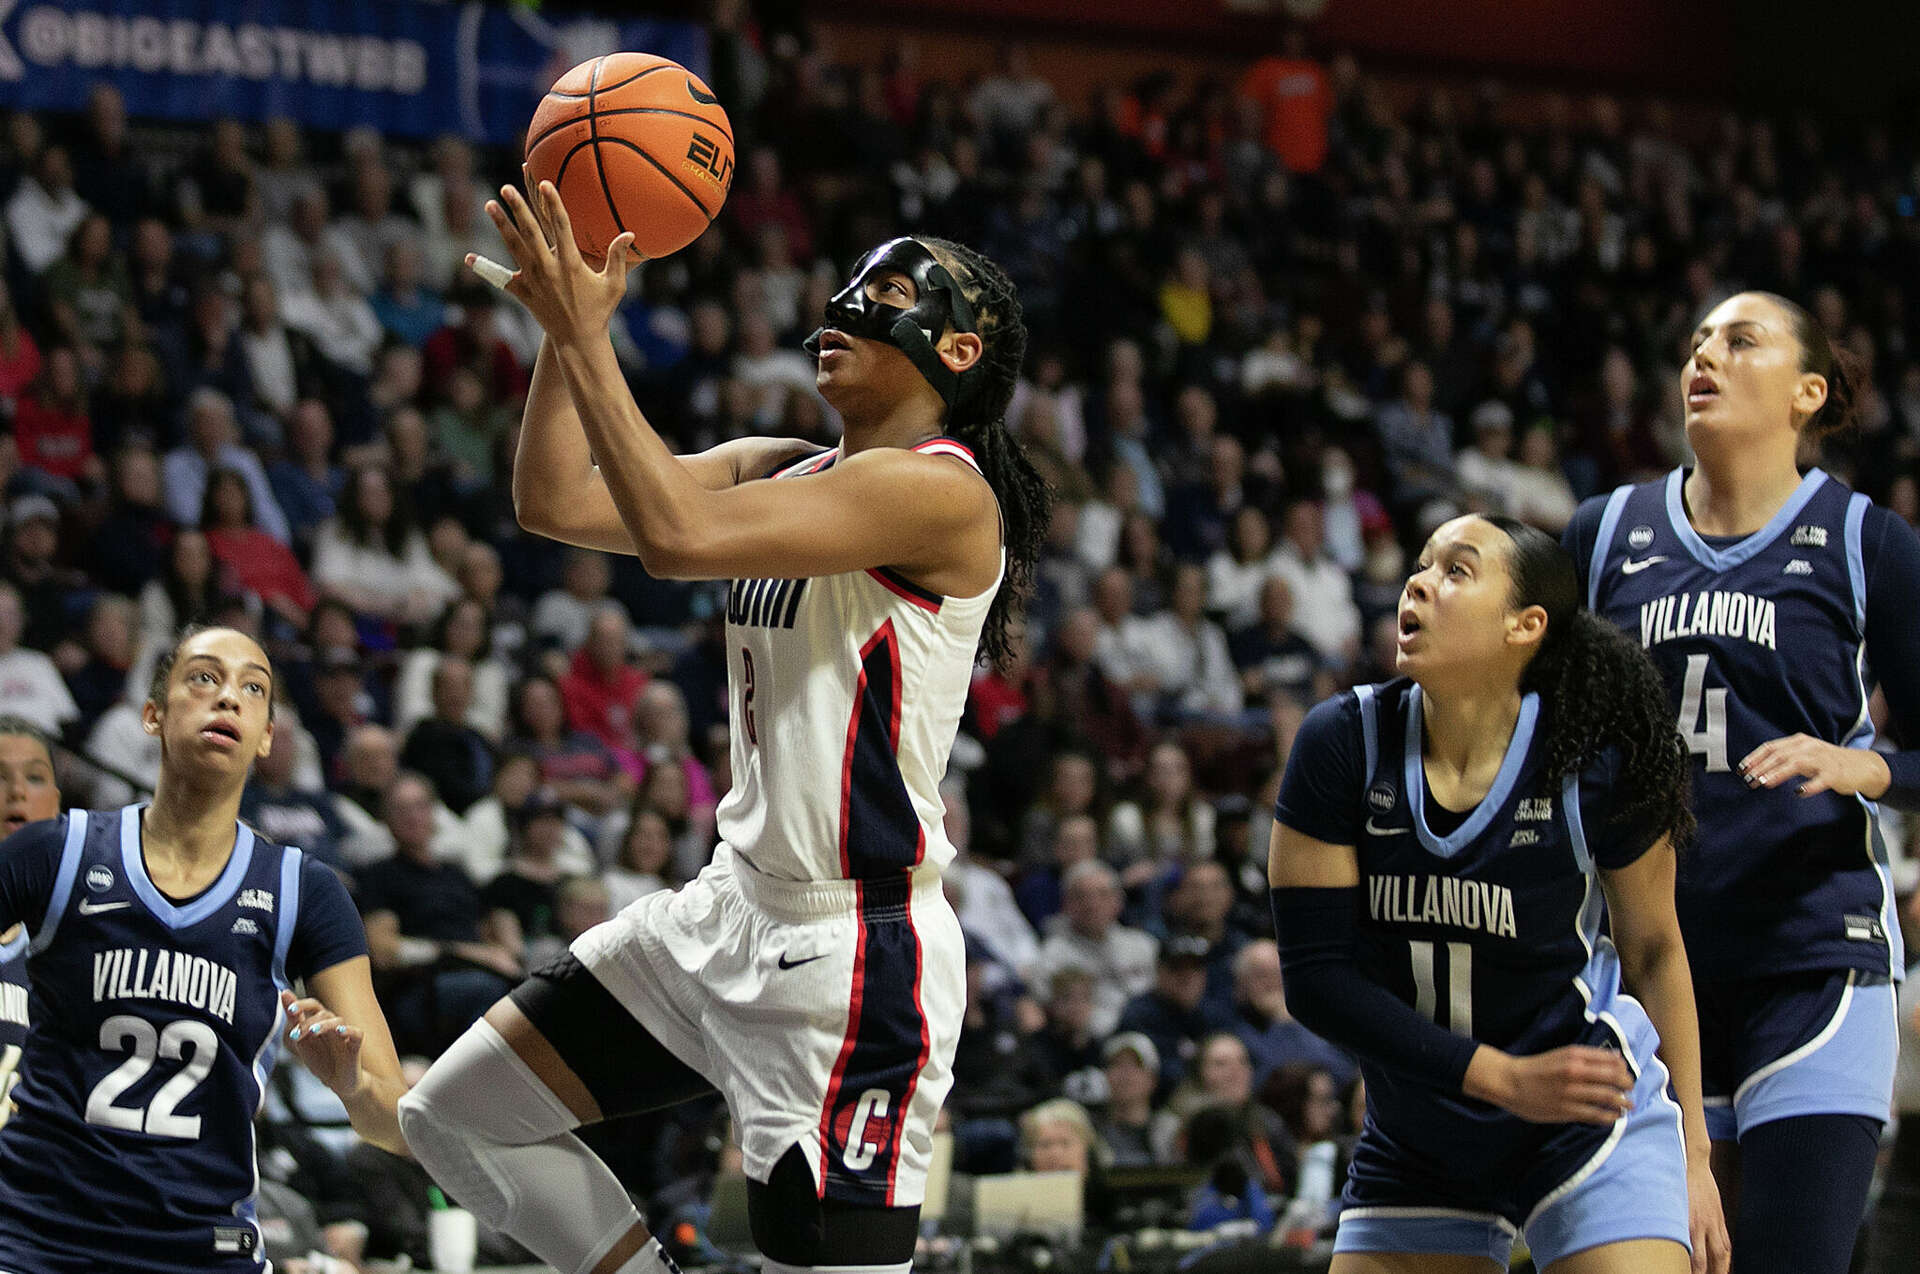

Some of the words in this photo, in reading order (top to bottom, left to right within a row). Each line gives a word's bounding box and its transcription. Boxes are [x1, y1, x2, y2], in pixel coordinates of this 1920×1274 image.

[20, 8, 427, 95] @BIGEASTWBB
[1640, 590, 1776, 651] VILLANOVA
[742, 647, 757, 746] 2
[1676, 653, 1732, 772] 4
[1368, 873, 1518, 939] VILLANOVA
[93, 947, 238, 1026] VILLANOVA
[1409, 940, 1473, 1041] 11
[84, 1014, 219, 1140] 22
